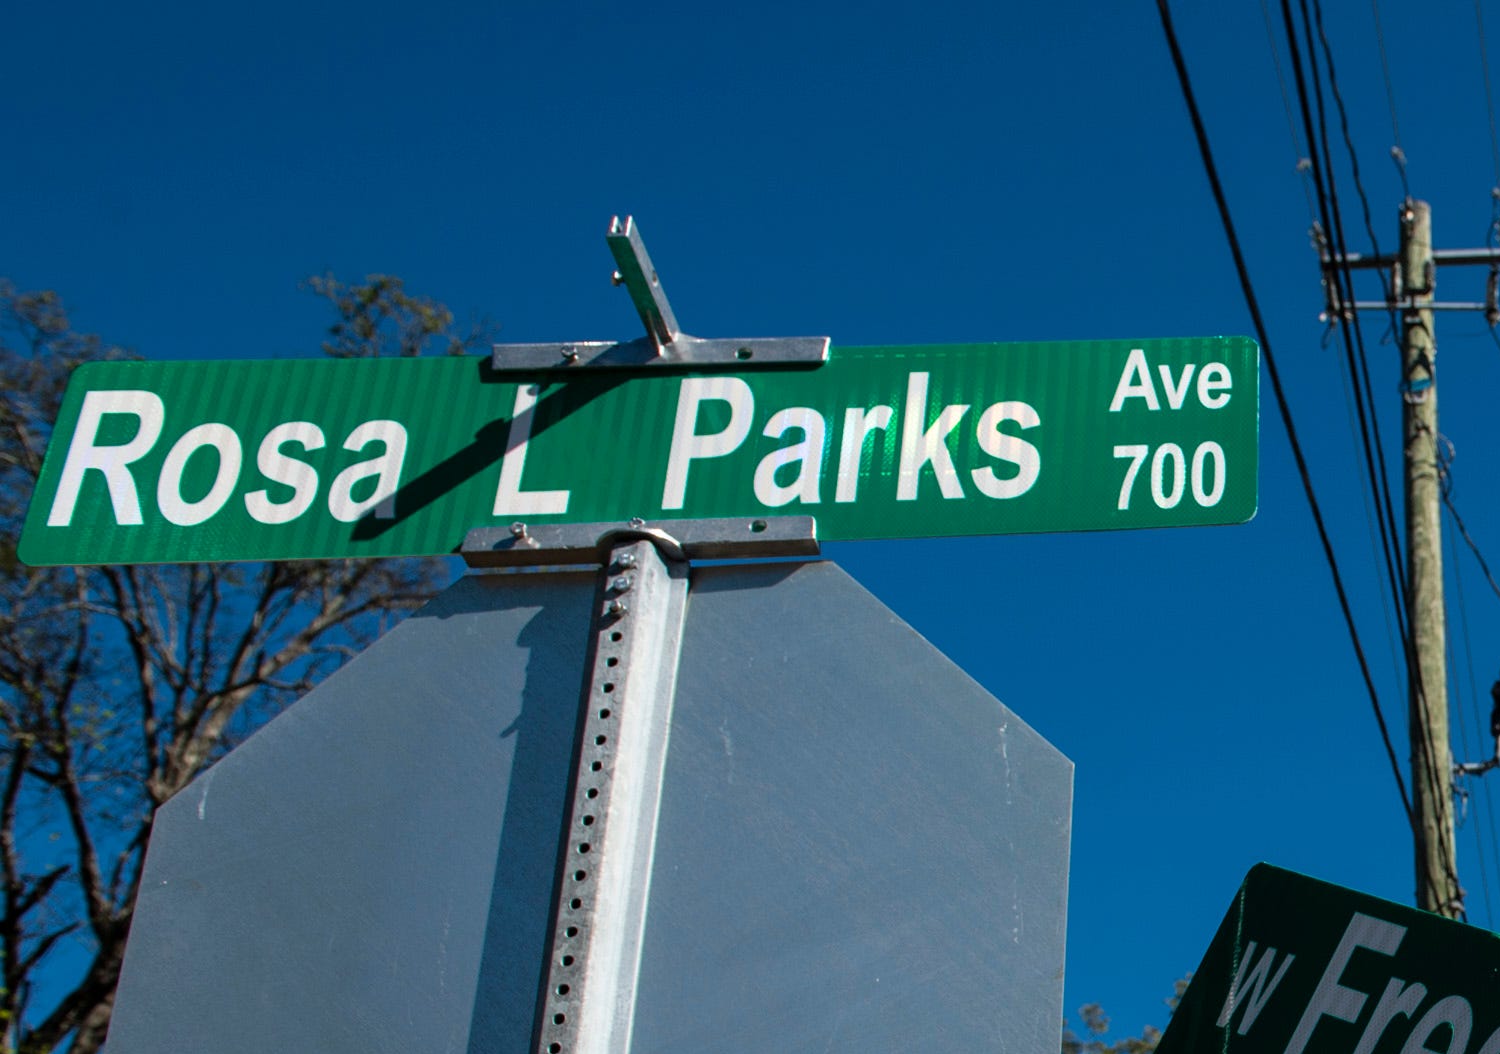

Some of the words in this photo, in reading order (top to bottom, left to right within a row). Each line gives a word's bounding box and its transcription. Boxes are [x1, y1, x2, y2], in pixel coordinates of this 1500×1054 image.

[1109, 348, 1233, 412] Ave
[47, 389, 407, 527] Rosa
[492, 384, 570, 517] L
[661, 371, 1041, 510] Parks
[1113, 440, 1226, 510] 700
